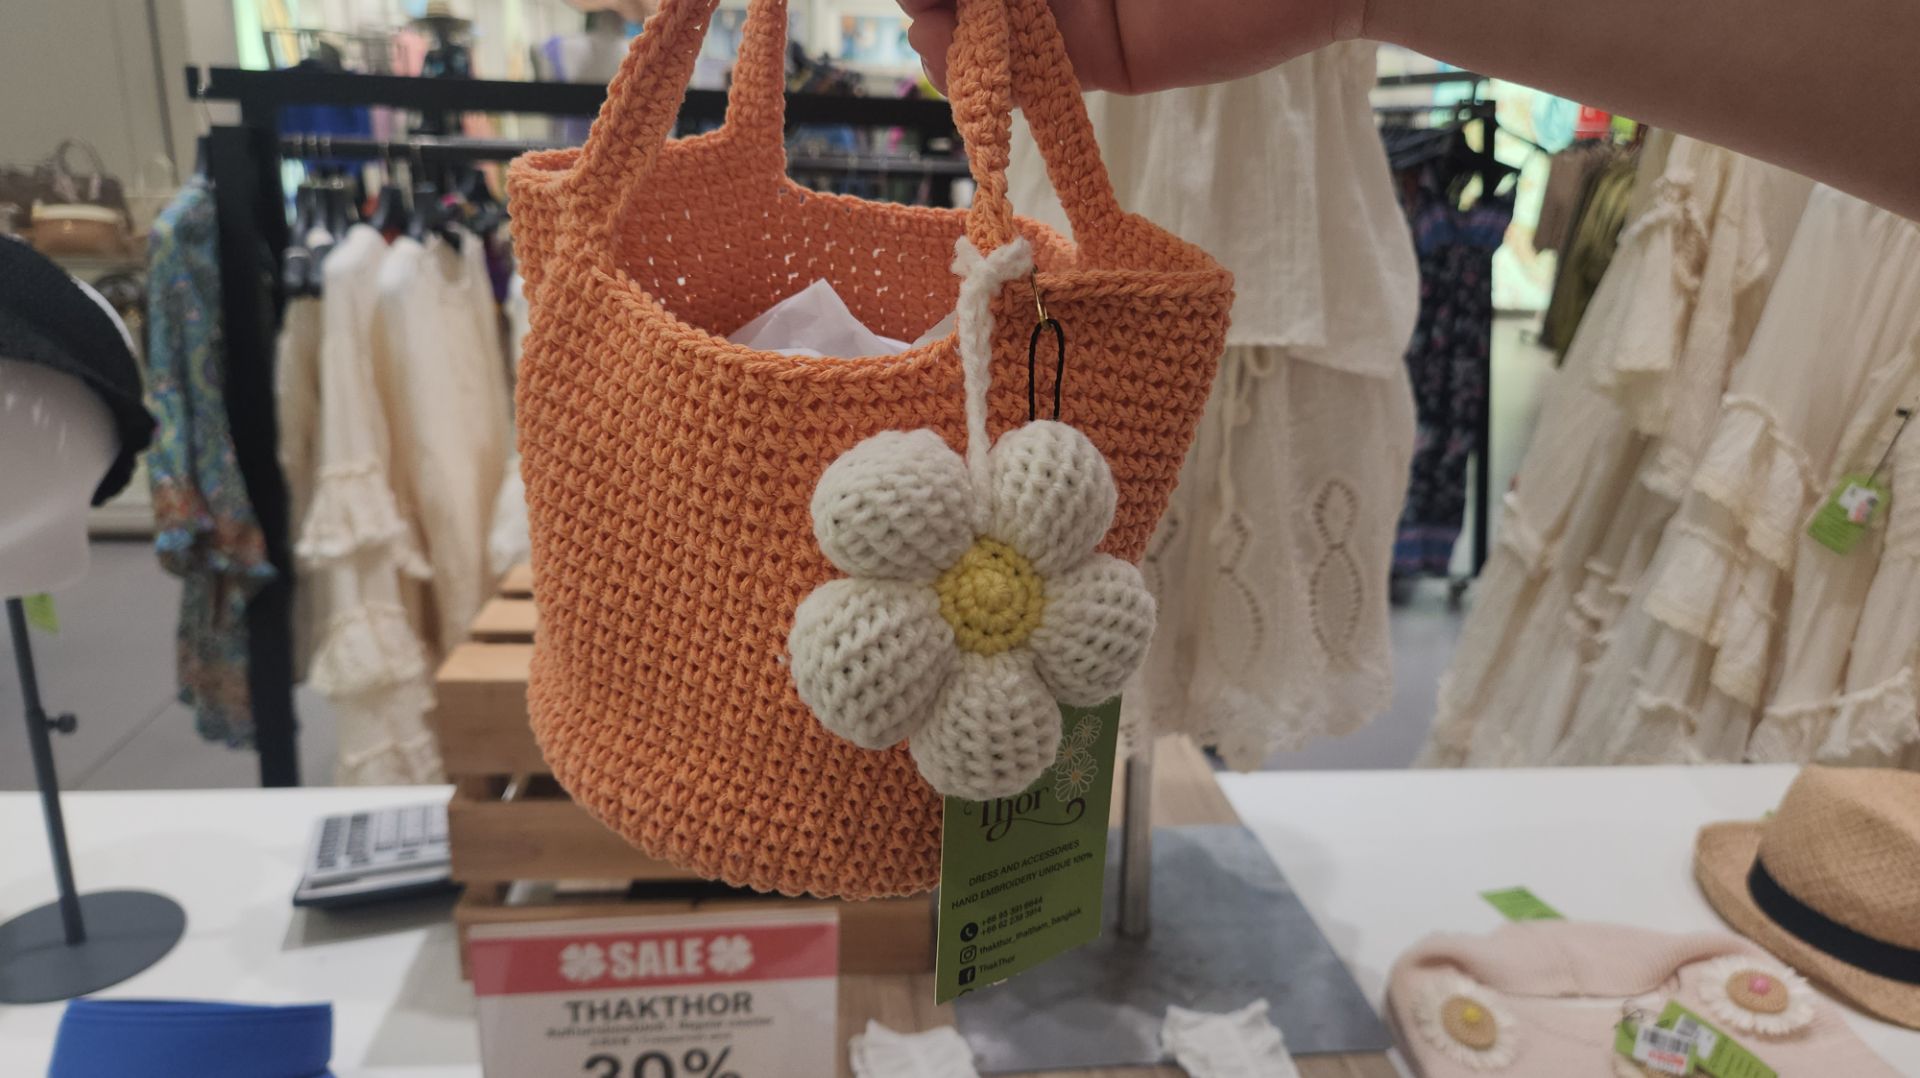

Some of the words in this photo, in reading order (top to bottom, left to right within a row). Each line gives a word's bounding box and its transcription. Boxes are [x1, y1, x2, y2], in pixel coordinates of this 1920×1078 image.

[951, 894, 978, 910] HAND
[980, 871, 1038, 900] EMBROIDERY
[1039, 858, 1072, 878] UNIQUE
[1073, 851, 1094, 865] 100%
[968, 868, 999, 887] DRESS
[1000, 861, 1020, 876] AND
[1021, 839, 1080, 868] ACCESSORIES
[608, 939, 704, 980] SALE
[565, 991, 752, 1025] THAKTHOR
